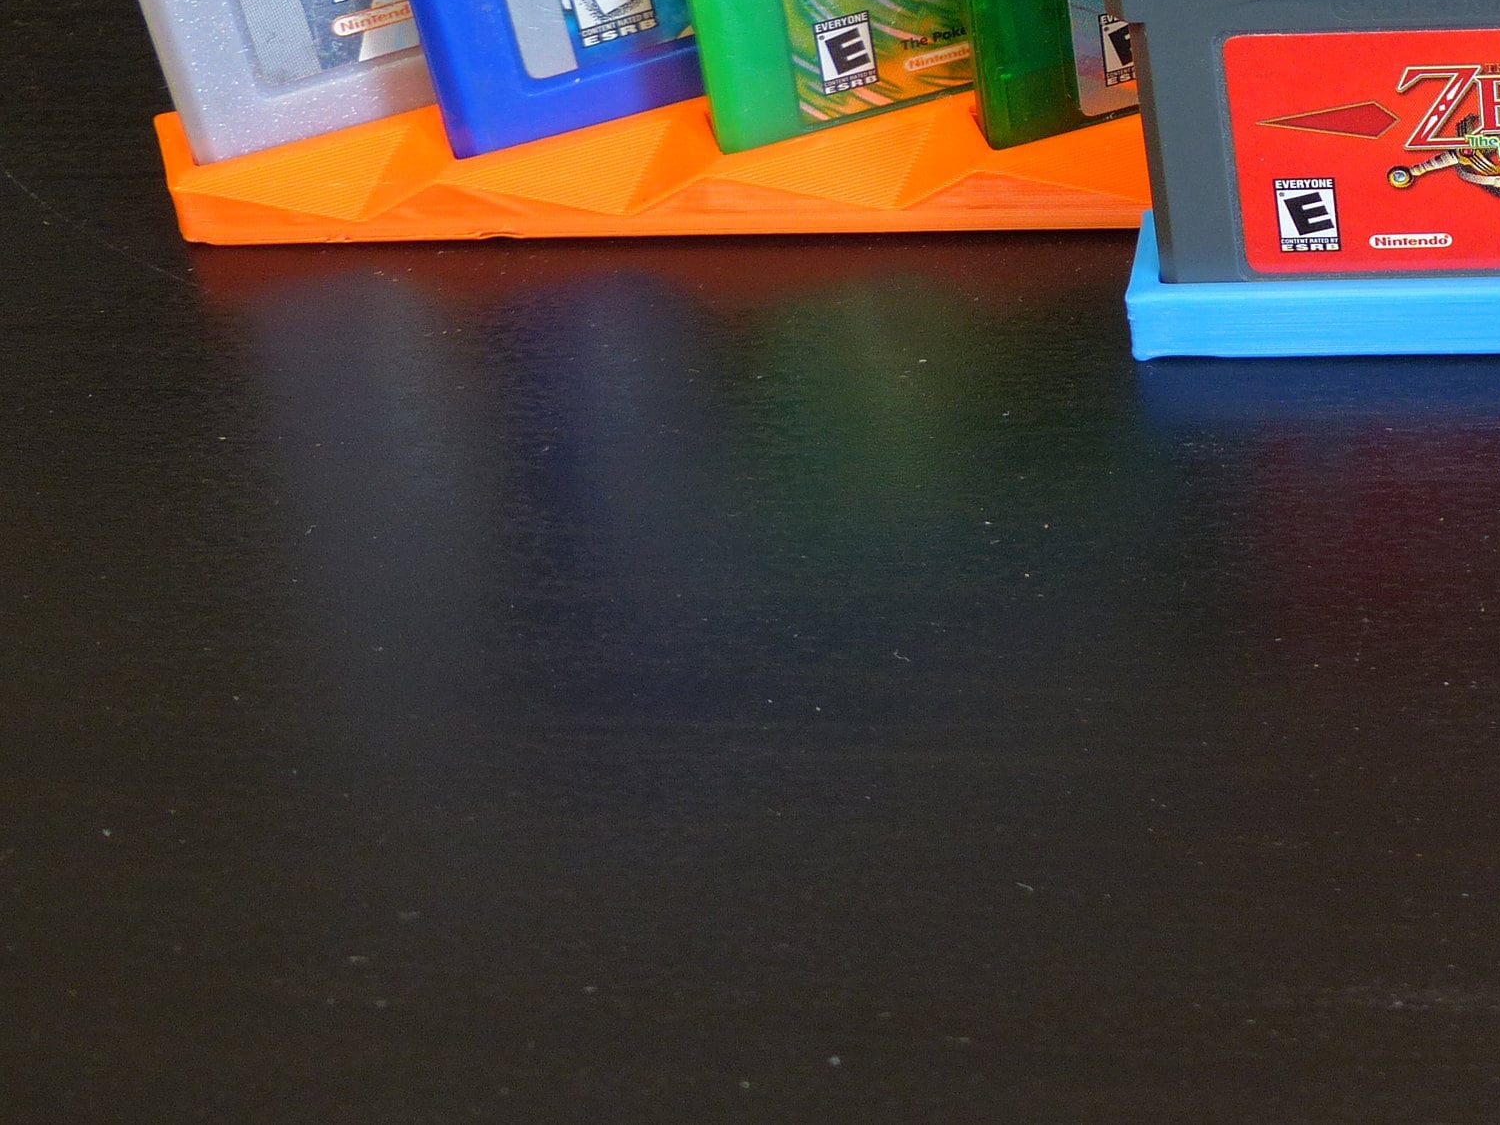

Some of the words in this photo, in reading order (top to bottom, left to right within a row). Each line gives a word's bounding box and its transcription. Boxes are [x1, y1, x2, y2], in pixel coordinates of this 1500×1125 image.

[340, 4, 411, 32] Nintend
[815, 11, 869, 33] EVERYONE
[583, 19, 657, 47] ESRB
[825, 27, 871, 75] E
[900, 36, 928, 50] The
[825, 75, 877, 94] ESRB
[1467, 135, 1499, 149] The
[1275, 178, 1334, 189] EVERYONE
[1283, 191, 1335, 236] E
[1282, 243, 1340, 252] ESRB
[1374, 234, 1448, 246] Nintendo
